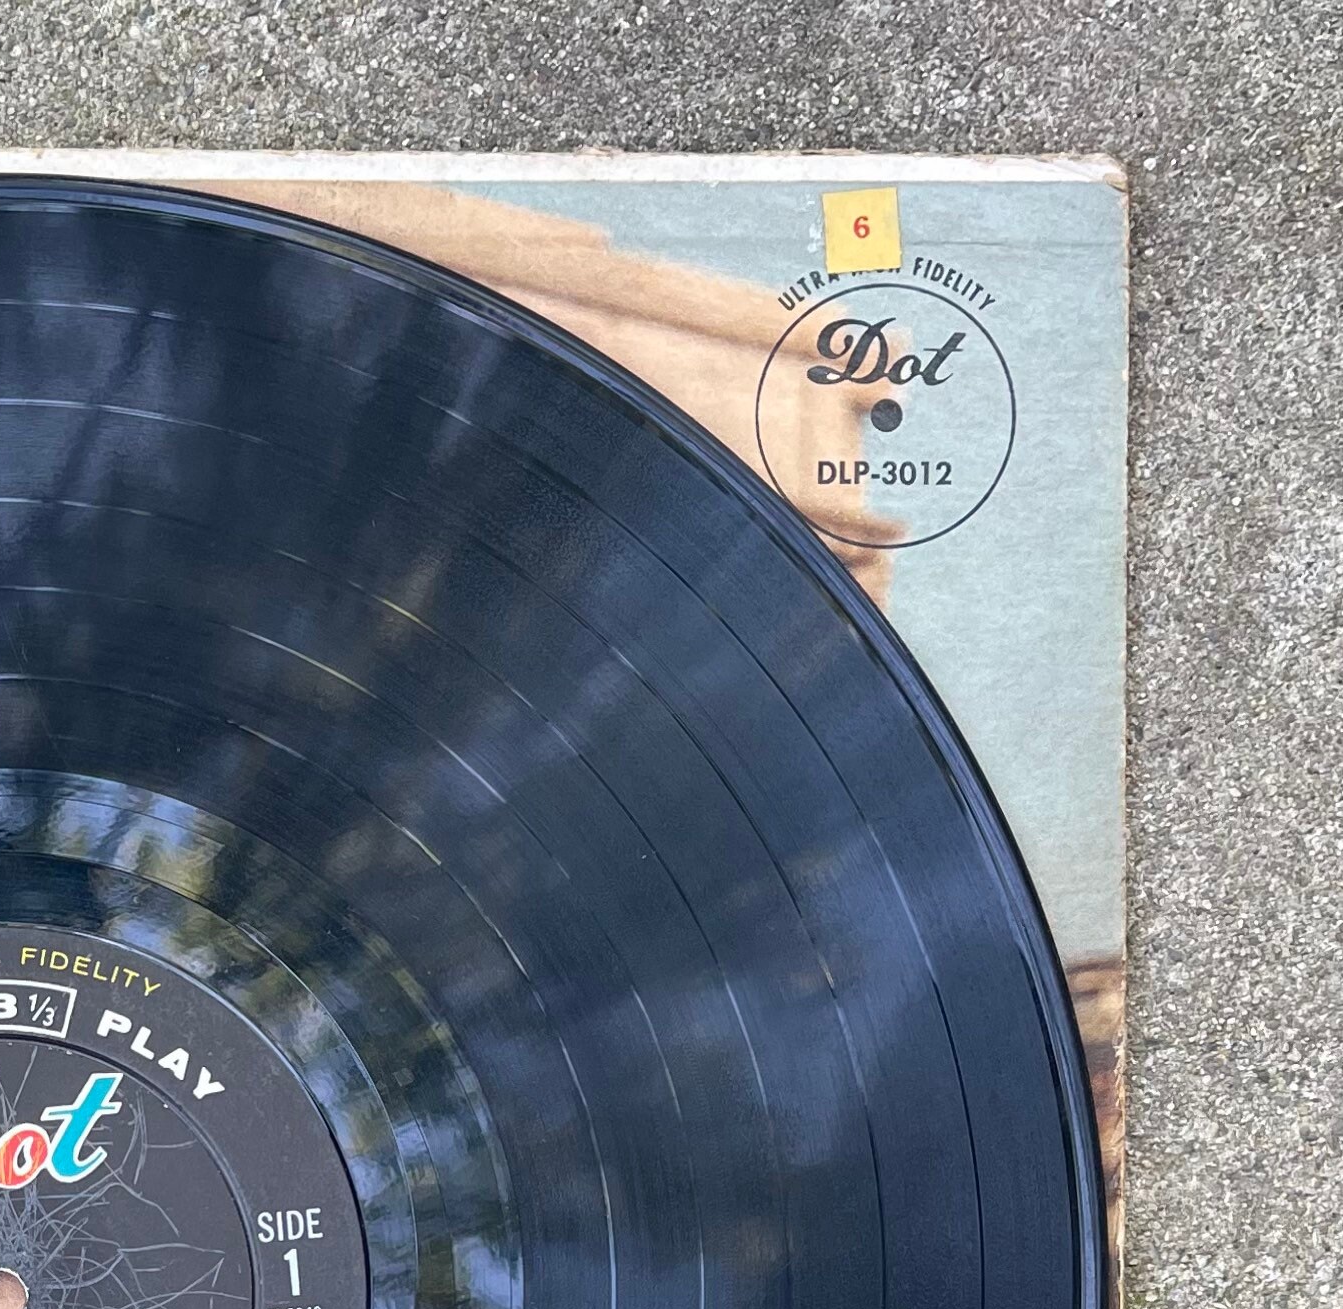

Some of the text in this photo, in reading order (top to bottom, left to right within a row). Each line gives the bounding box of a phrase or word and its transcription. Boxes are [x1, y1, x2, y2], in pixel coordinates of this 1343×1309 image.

[853, 215, 871, 239] 6
[912, 256, 996, 310] FIDELITY
[807, 317, 967, 386] Dot
[817, 460, 953, 486] DLP-3012
[20, 946, 162, 997] FIDELITY
[96, 1009, 226, 1100] PLAY
[257, 1207, 324, 1243] SIDE
[283, 1248, 301, 1297] 1
